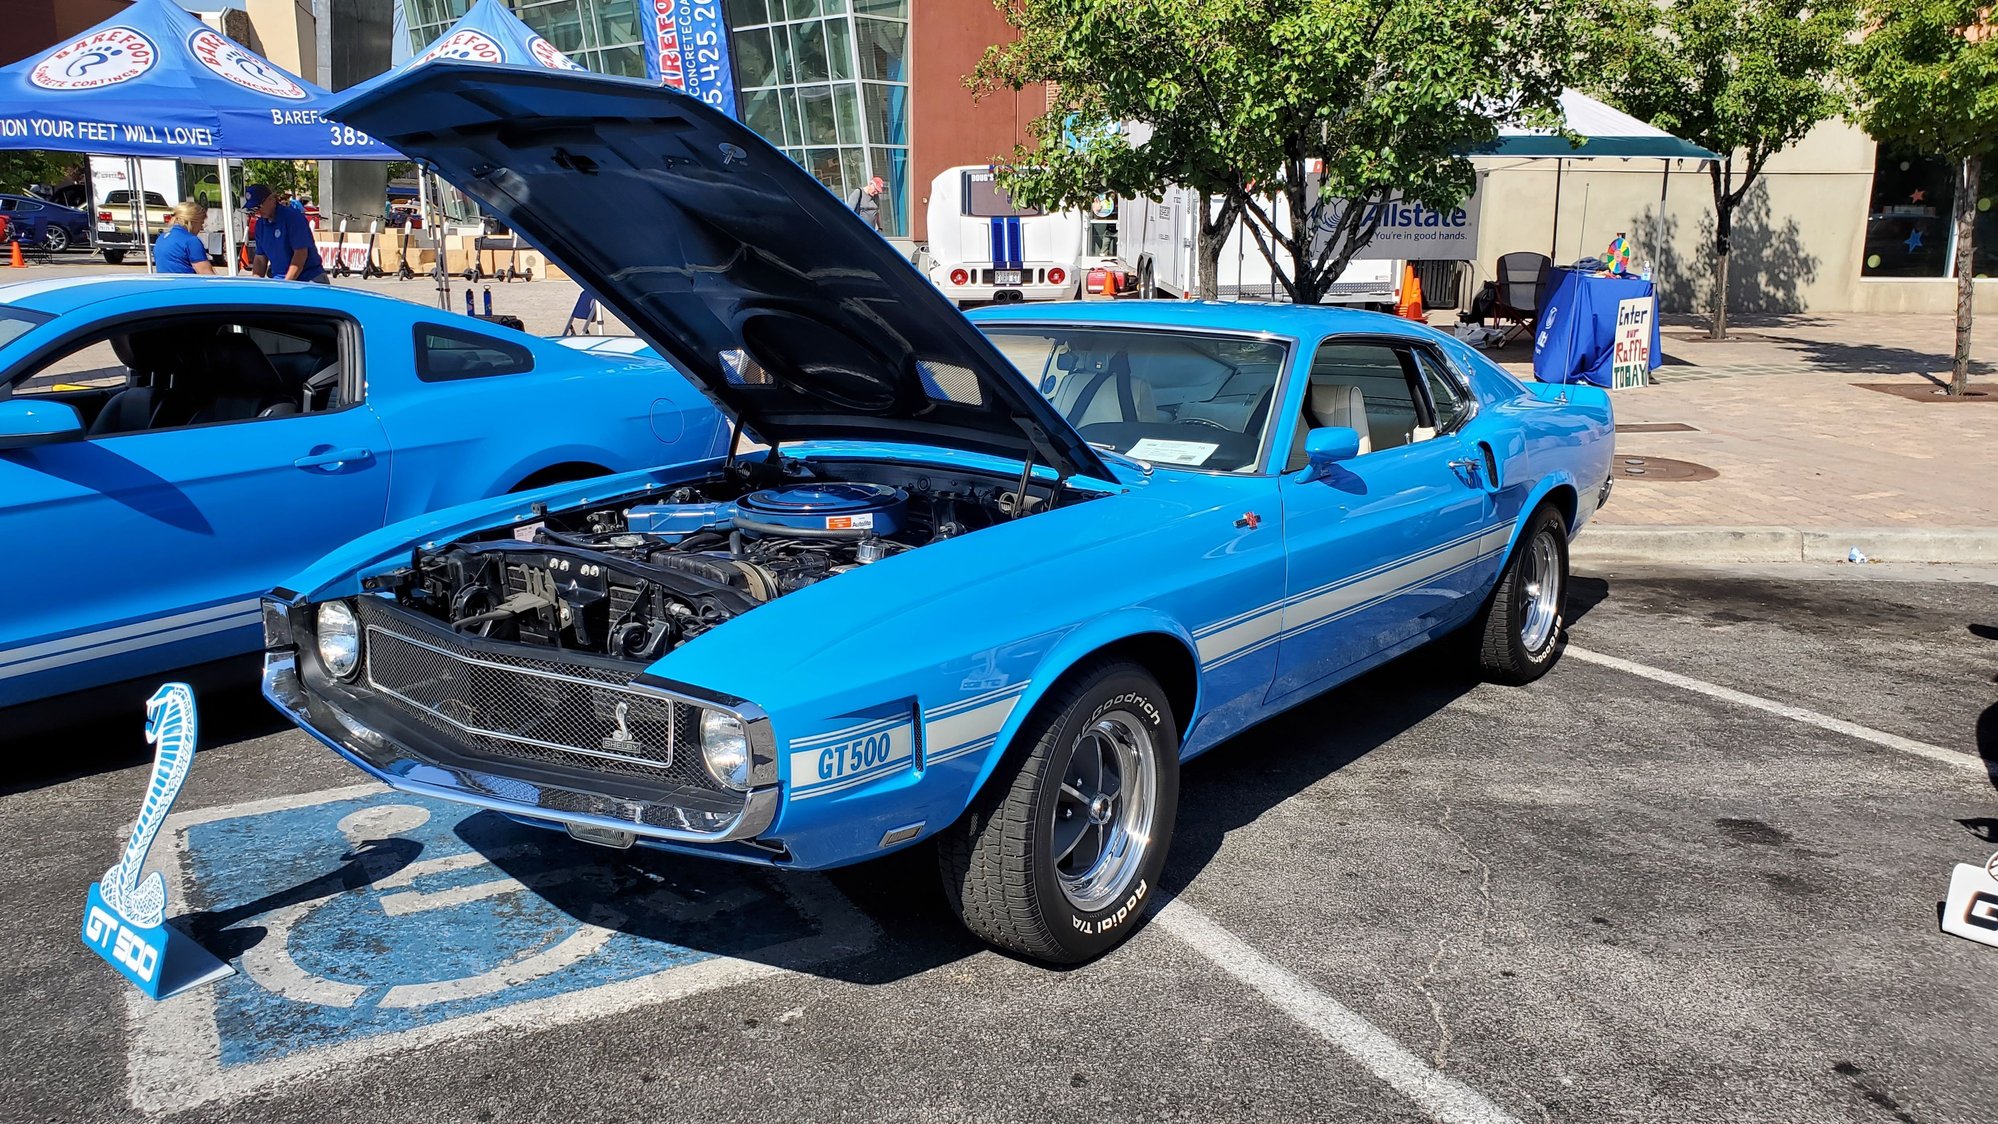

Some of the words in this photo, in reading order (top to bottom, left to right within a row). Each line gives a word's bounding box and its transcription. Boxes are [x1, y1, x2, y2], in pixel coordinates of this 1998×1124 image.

[55, 31, 150, 66] BAREFOOT
[693, 0, 724, 112] 5.425.2
[71, 68, 139, 88] COATINGS
[271, 109, 336, 125] BAREF
[30, 119, 74, 139] YOUR
[78, 122, 118, 141] FEET
[122, 124, 163, 144] WILL
[164, 127, 212, 146] LOVE!
[1375, 231, 1402, 241] You're
[1403, 231, 1412, 240] in
[1414, 231, 1437, 242] good
[1438, 231, 1468, 241] hands.
[1619, 305, 1648, 327] Enter
[1626, 328, 1640, 339] our
[1615, 338, 1648, 364] Raffle
[1613, 364, 1649, 389] TODAY
[604, 740, 639, 752] SHELBY
[1097, 878, 1147, 934] Radial
[1072, 914, 1093, 934] T/A
[86, 905, 119, 949] GT
[112, 925, 158, 983] 500
